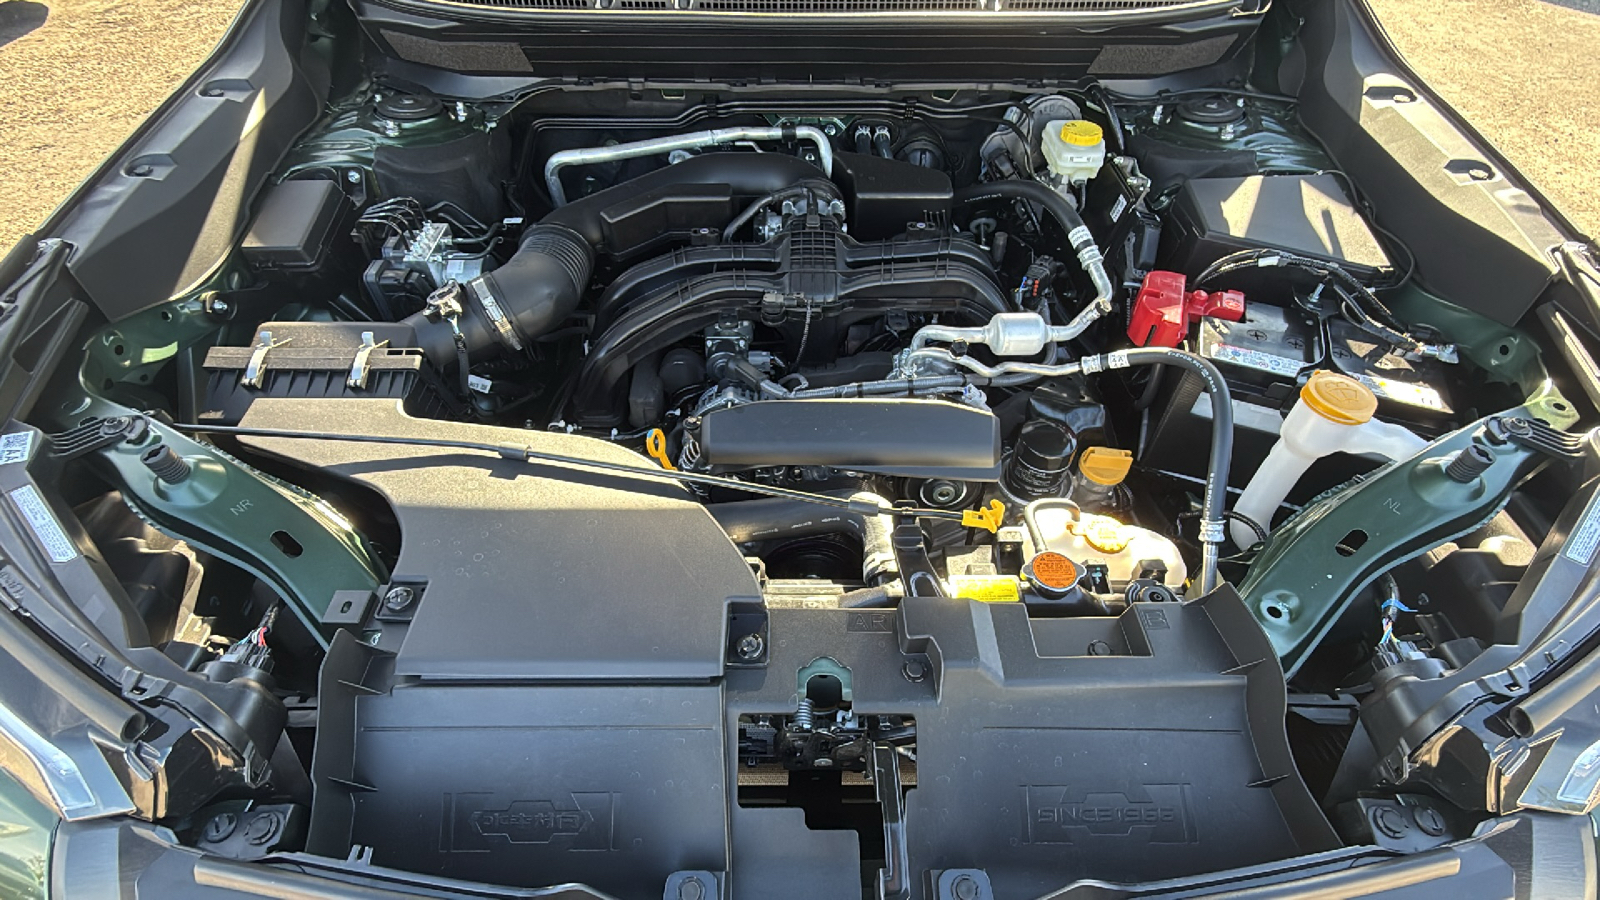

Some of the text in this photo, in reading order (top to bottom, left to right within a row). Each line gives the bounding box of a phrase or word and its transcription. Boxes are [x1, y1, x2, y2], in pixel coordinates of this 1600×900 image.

[229, 498, 254, 516] NR
[1382, 497, 1401, 515] NL
[854, 613, 887, 630] AR
